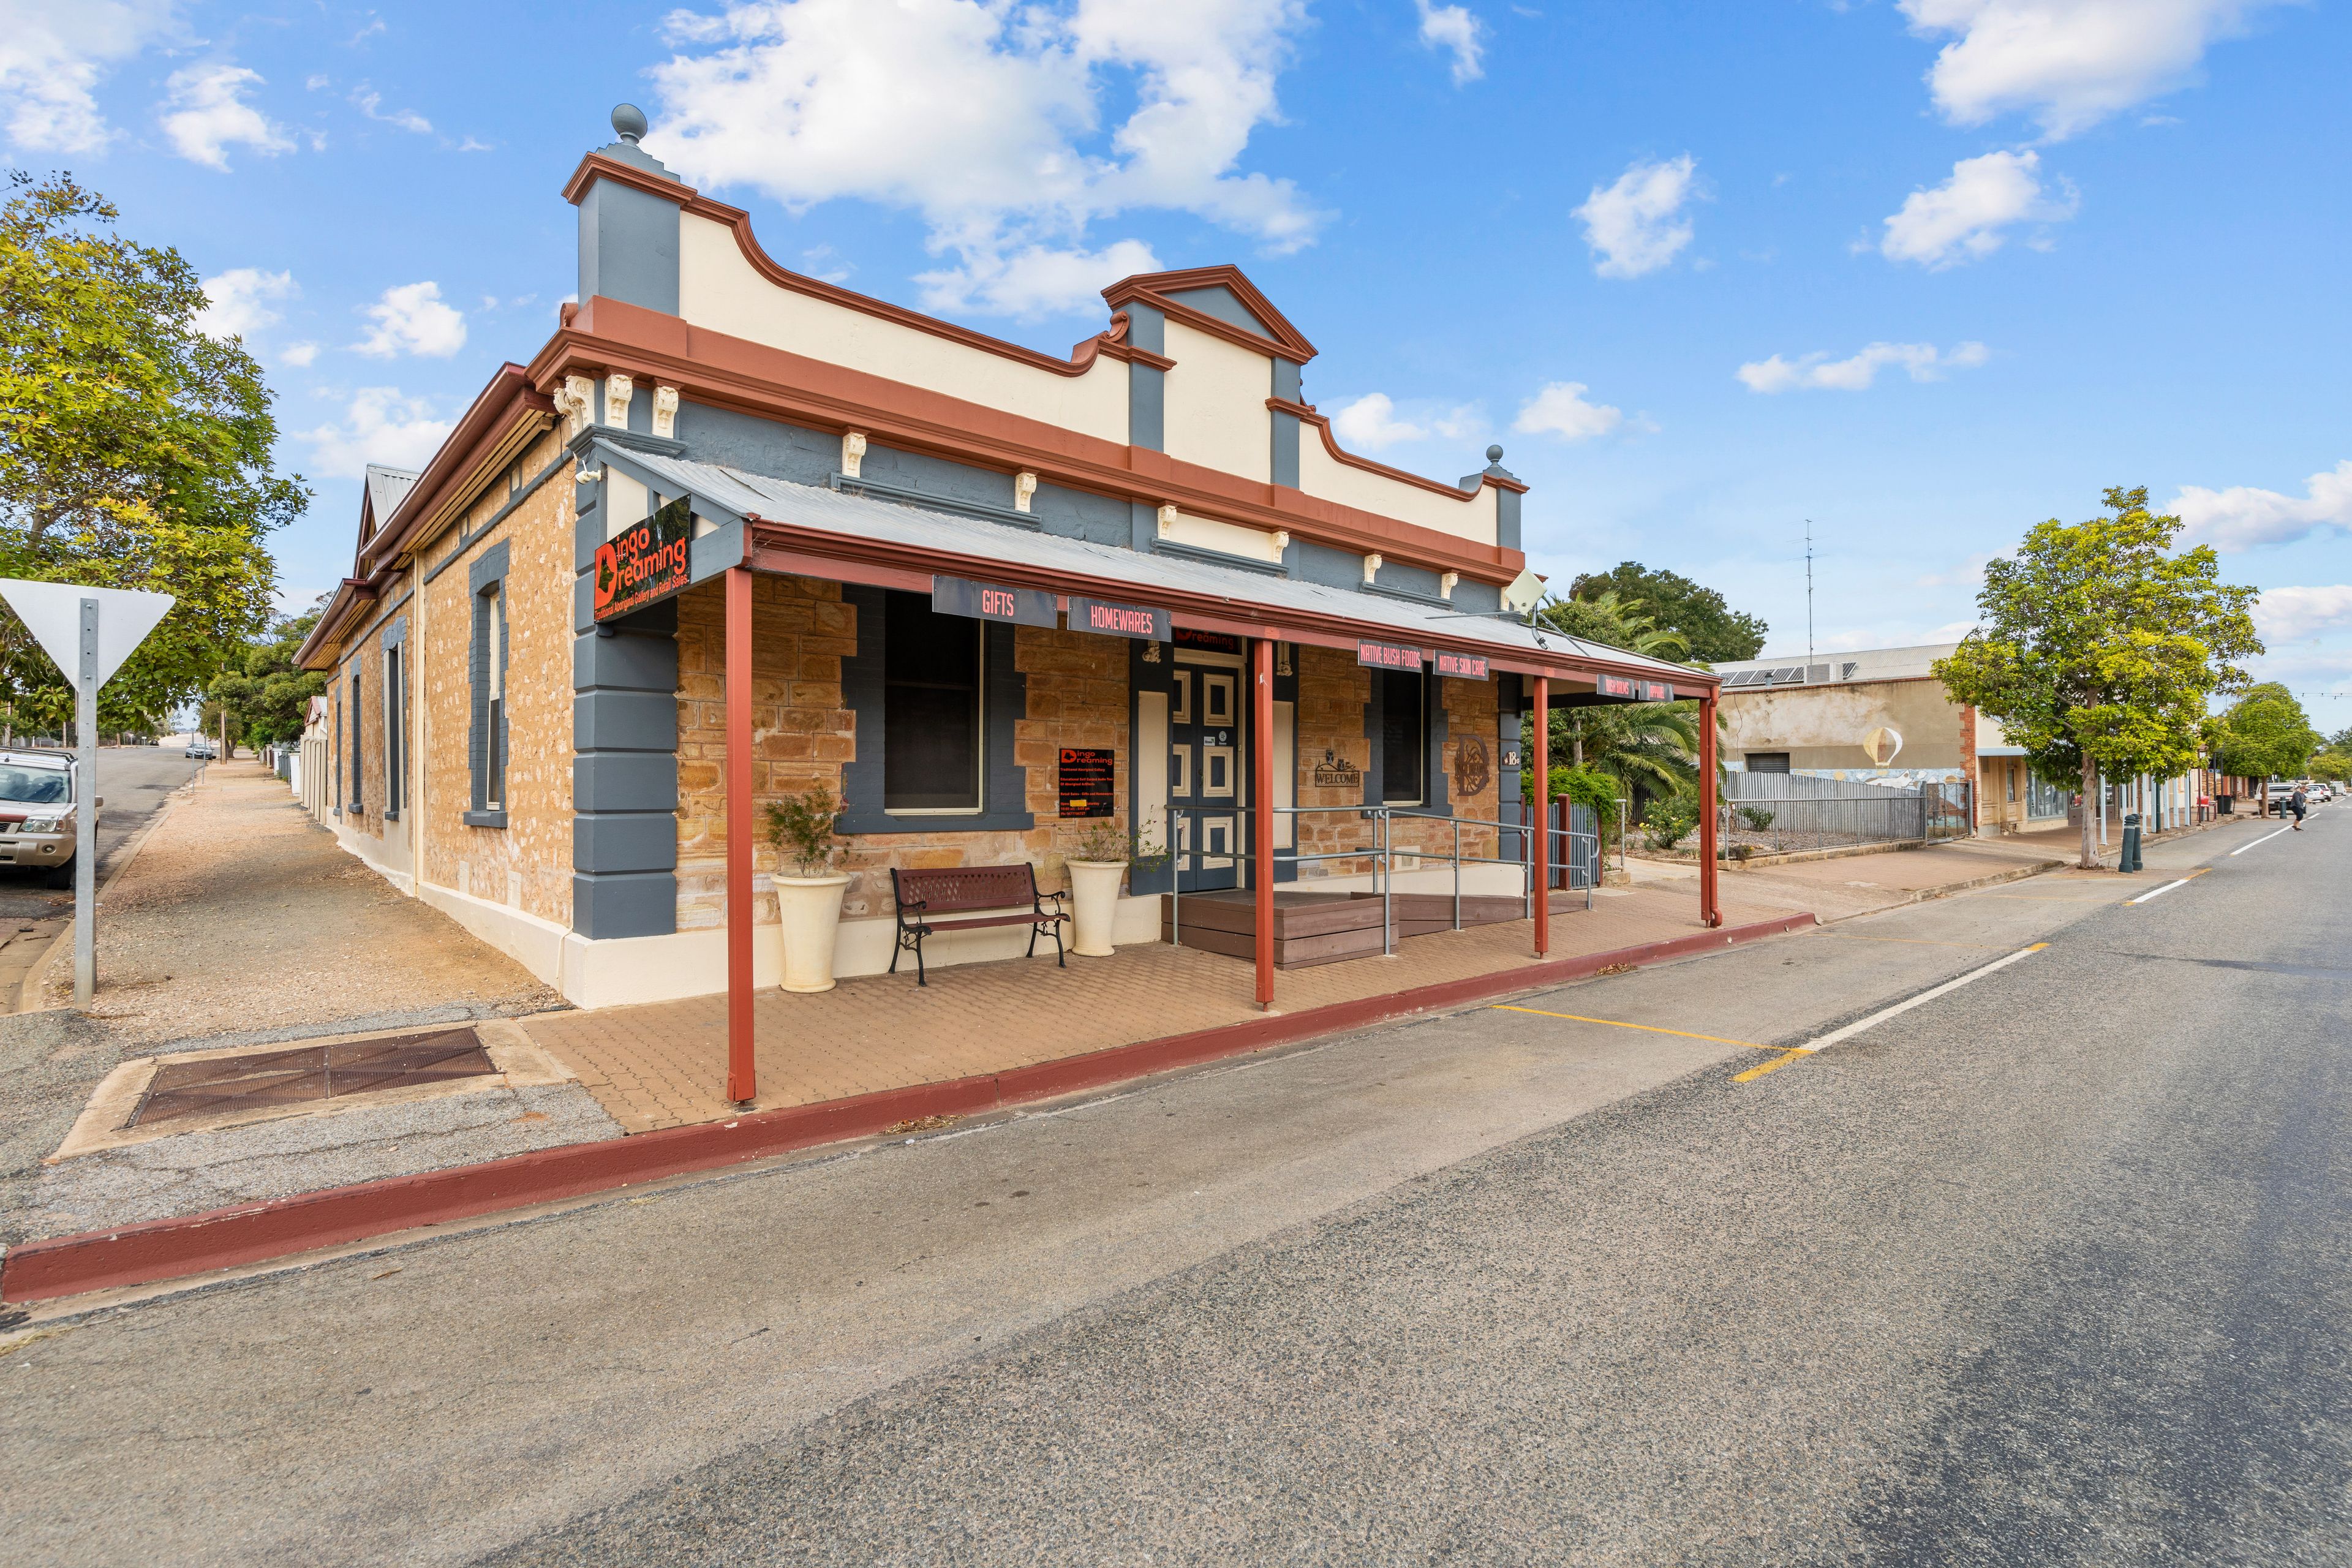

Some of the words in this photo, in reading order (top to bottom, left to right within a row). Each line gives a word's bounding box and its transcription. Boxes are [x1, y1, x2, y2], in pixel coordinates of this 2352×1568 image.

[595, 603, 614, 620] Traditional
[614, 594, 634, 612] Aboriginal
[634, 590, 650, 602] Gallery
[658, 578, 671, 594] Retail
[982, 590, 1014, 616] GIFTS
[1091, 605, 1153, 634] HOMEWARES
[1360, 644, 1382, 663] NATIVE
[1383, 647, 1400, 666] BUSH
[1401, 650, 1421, 668] FOODS
[1439, 655, 1458, 673] NATIVE
[1459, 657, 1471, 674] SKIN
[1472, 660, 1485, 676] CARE
[1605, 679, 1616, 693] BUSH
[1616, 680, 1629, 695] BALMS
[1649, 685, 1665, 699] APPAREL
[1508, 752, 1517, 765] 18
[1316, 773, 1359, 785] WELCOME
